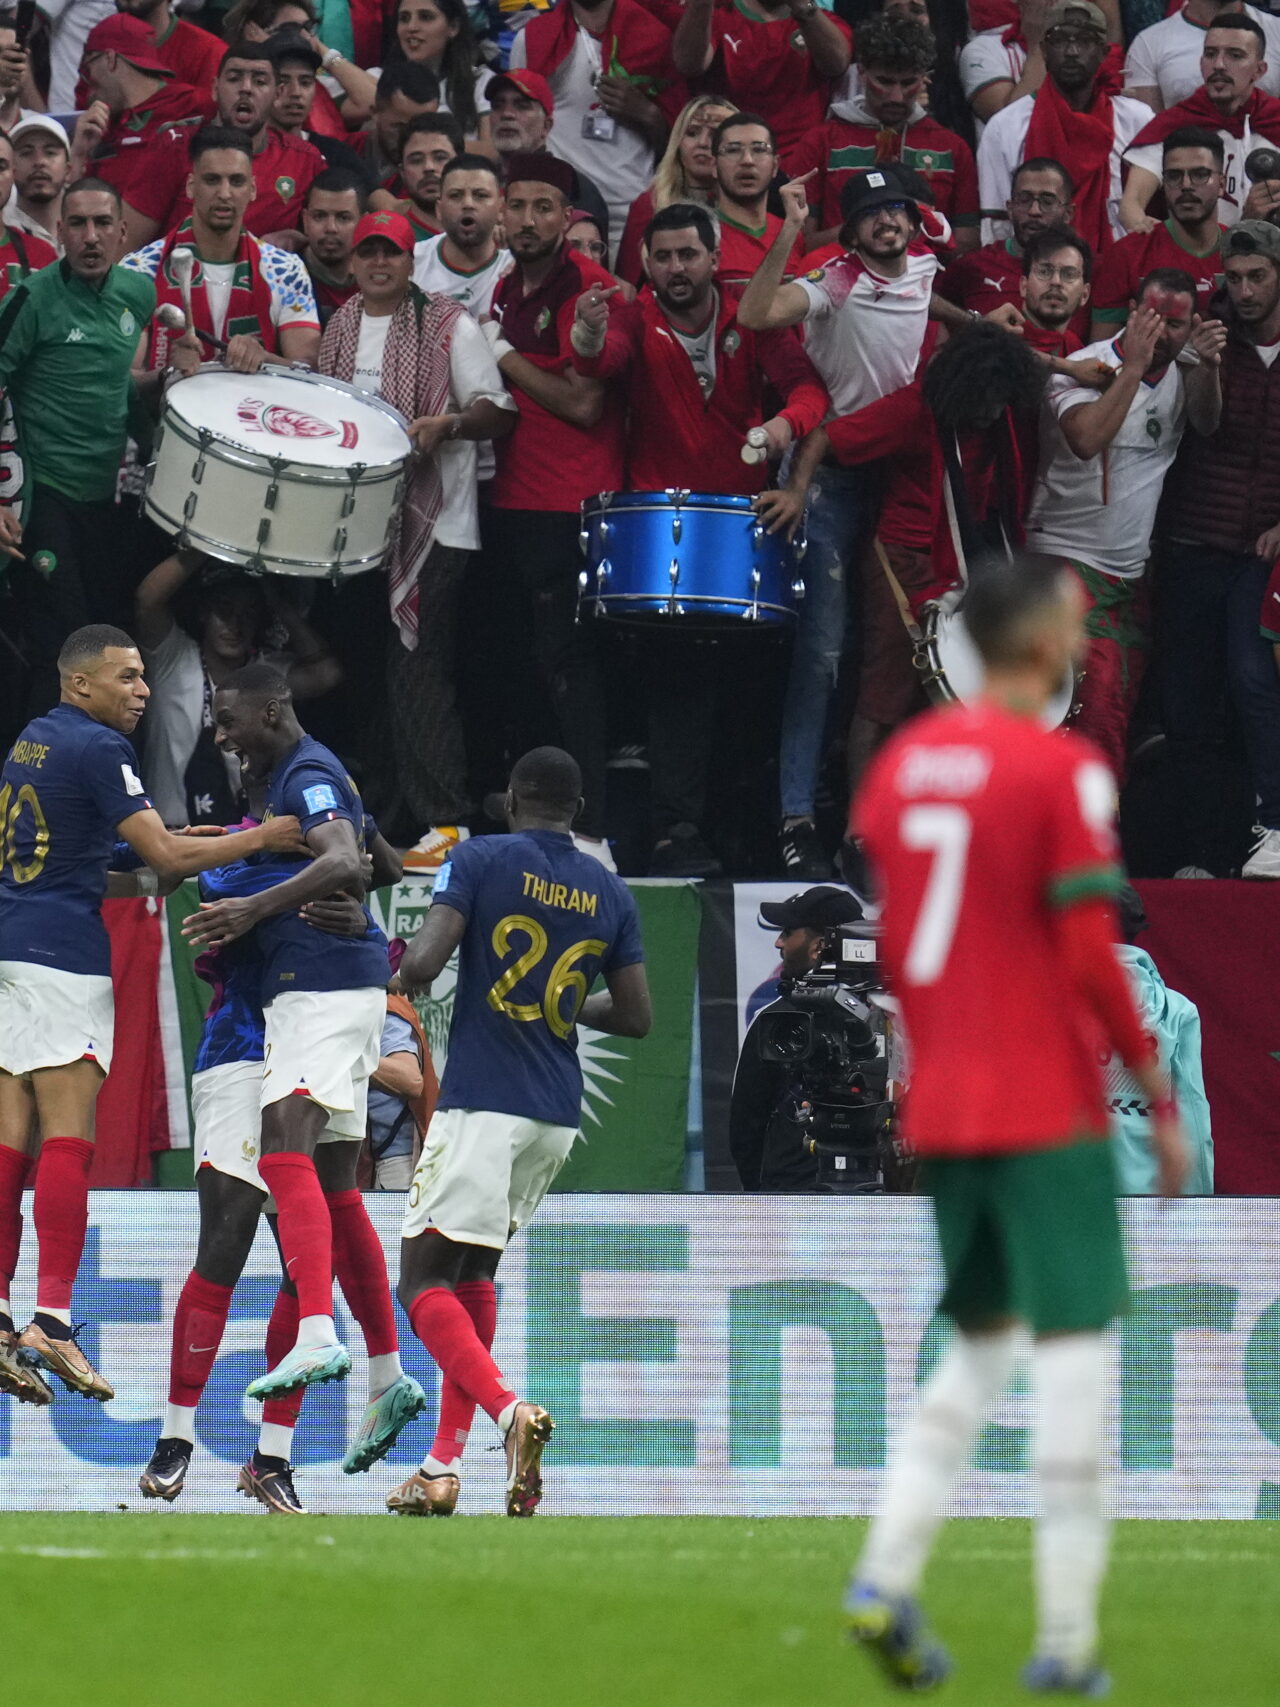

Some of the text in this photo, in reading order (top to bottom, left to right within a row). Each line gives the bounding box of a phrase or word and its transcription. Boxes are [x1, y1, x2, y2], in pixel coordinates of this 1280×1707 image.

[155, 326, 169, 369] MARO
[355, 366, 381, 377] encia
[523, 871, 598, 917] THURAM
[900, 803, 971, 986] 7
[397, 914, 426, 934] RA
[486, 914, 608, 1041] 26
